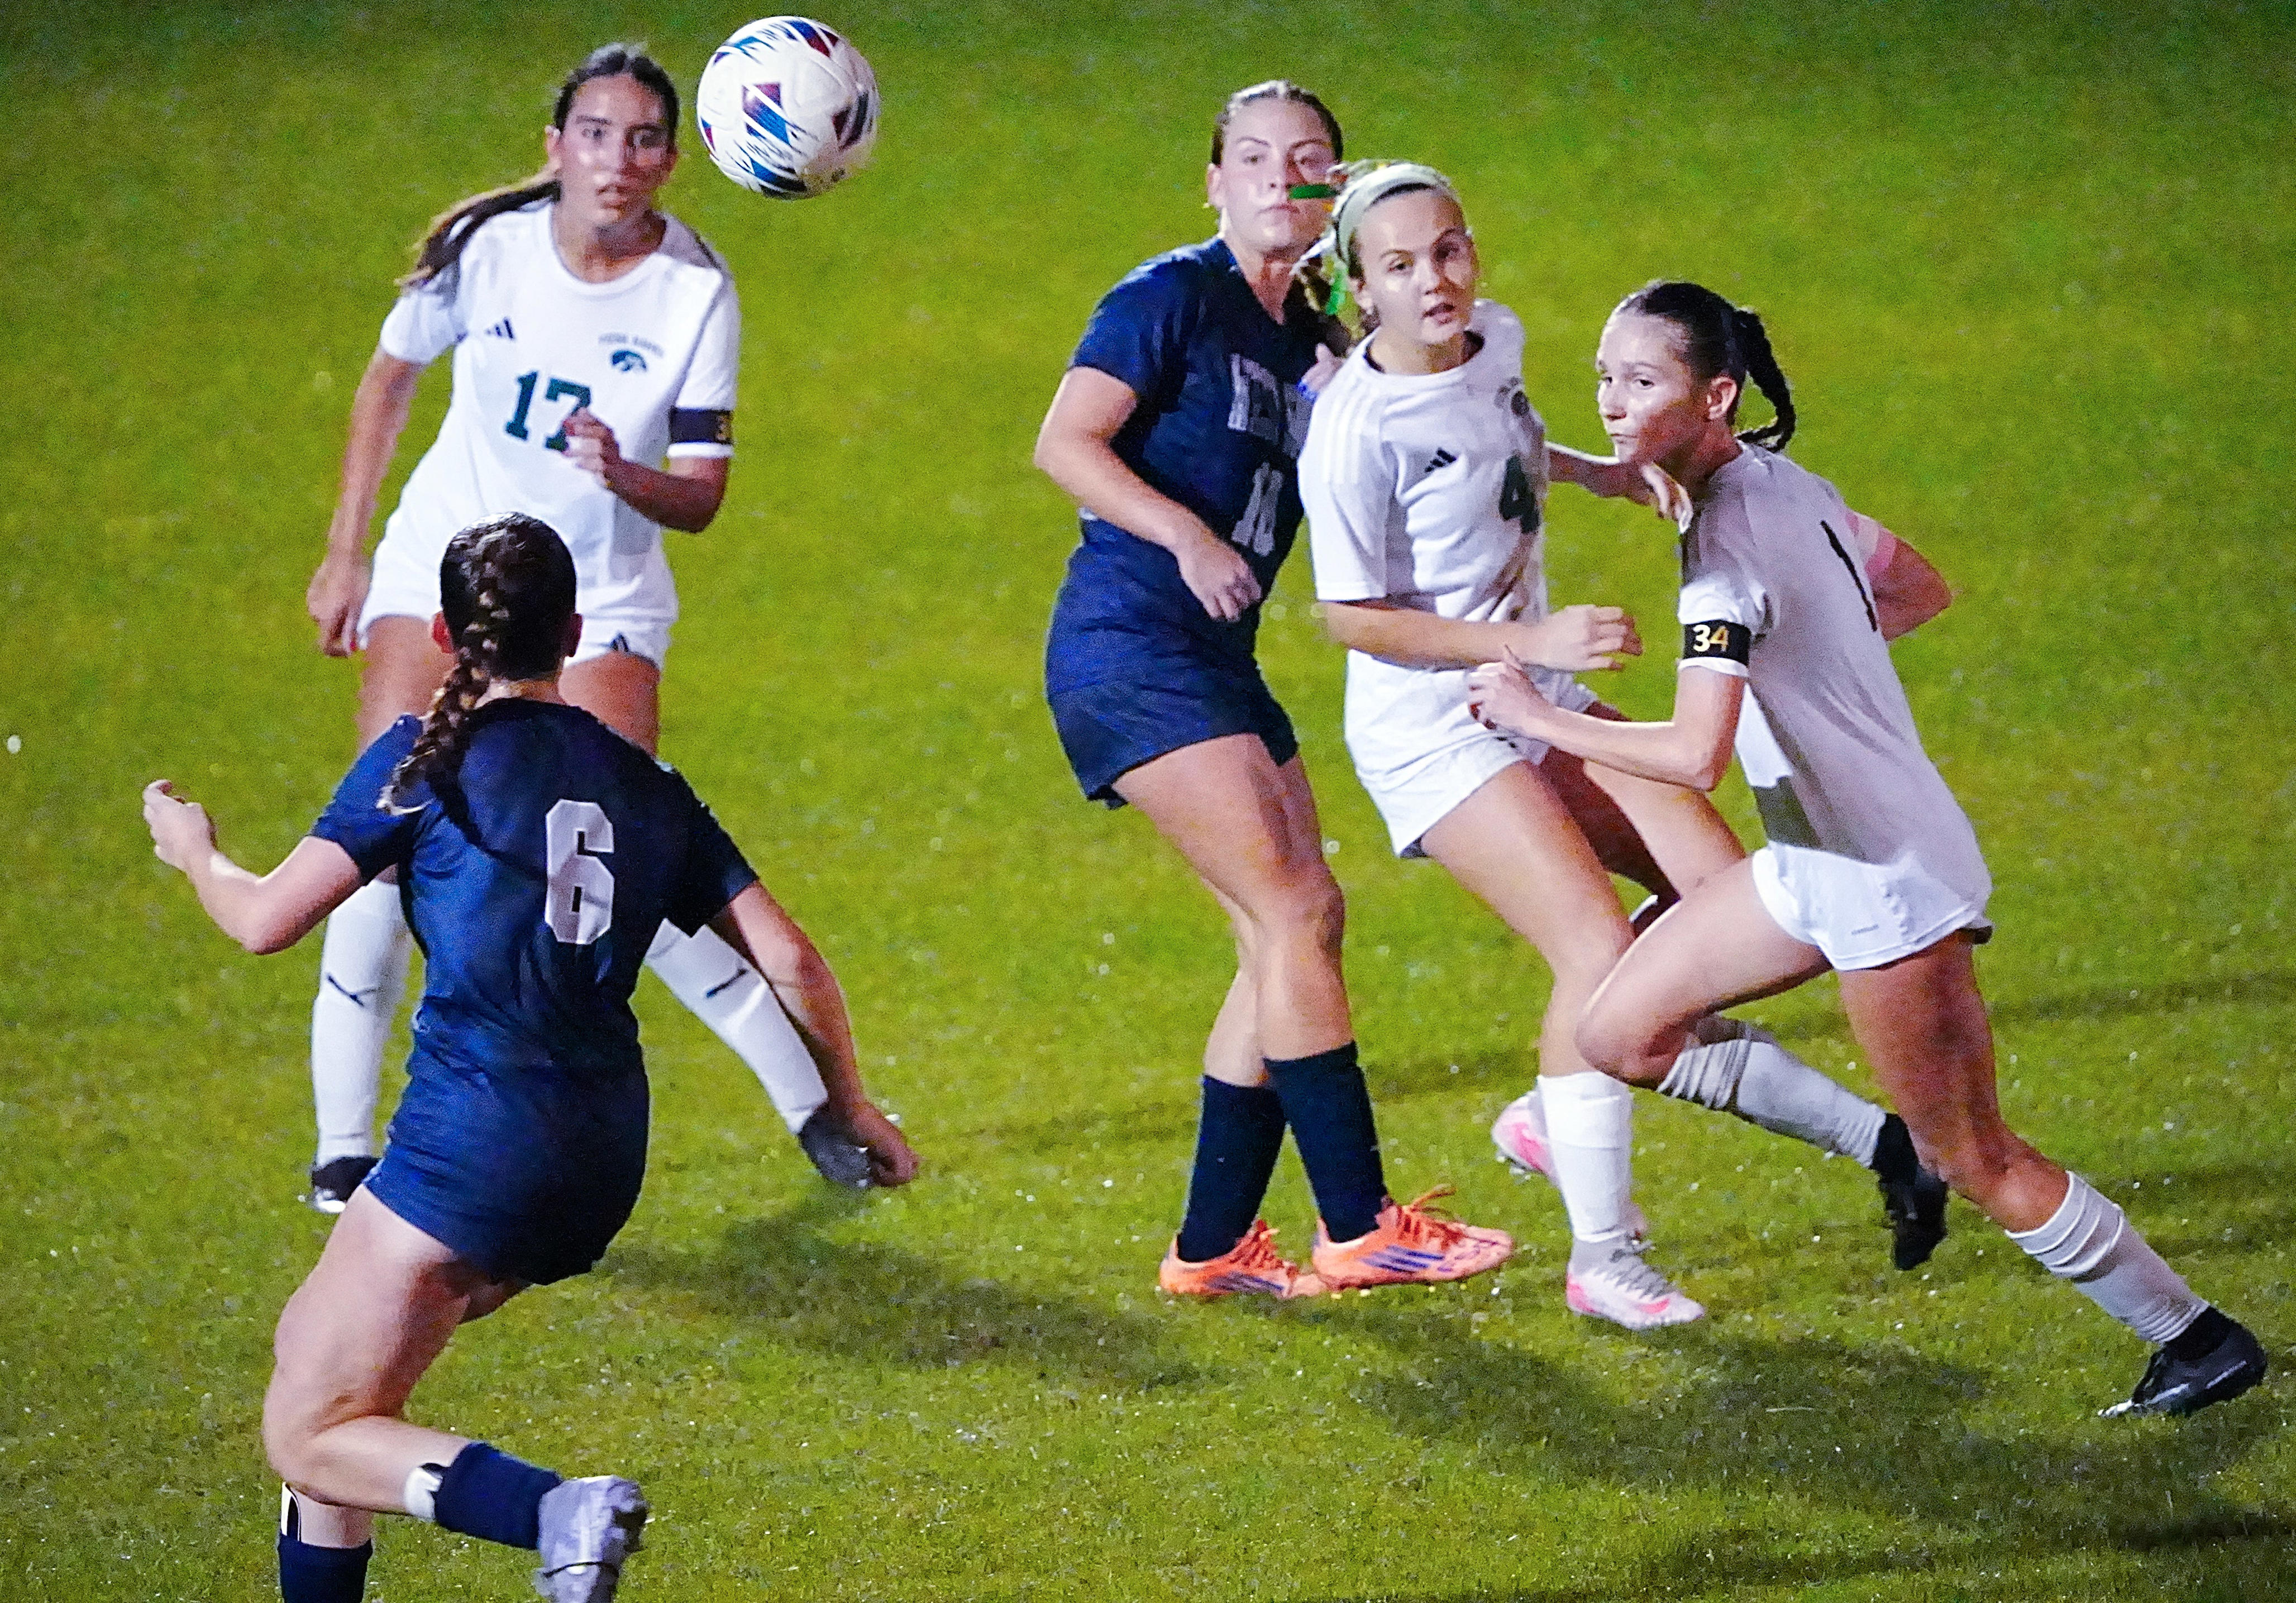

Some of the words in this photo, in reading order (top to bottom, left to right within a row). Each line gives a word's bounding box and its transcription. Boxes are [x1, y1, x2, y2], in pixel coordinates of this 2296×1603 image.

[506, 371, 591, 452] 17
[1498, 452, 1540, 534] 4
[1693, 624, 1729, 652] 34
[545, 798, 614, 944] 6
